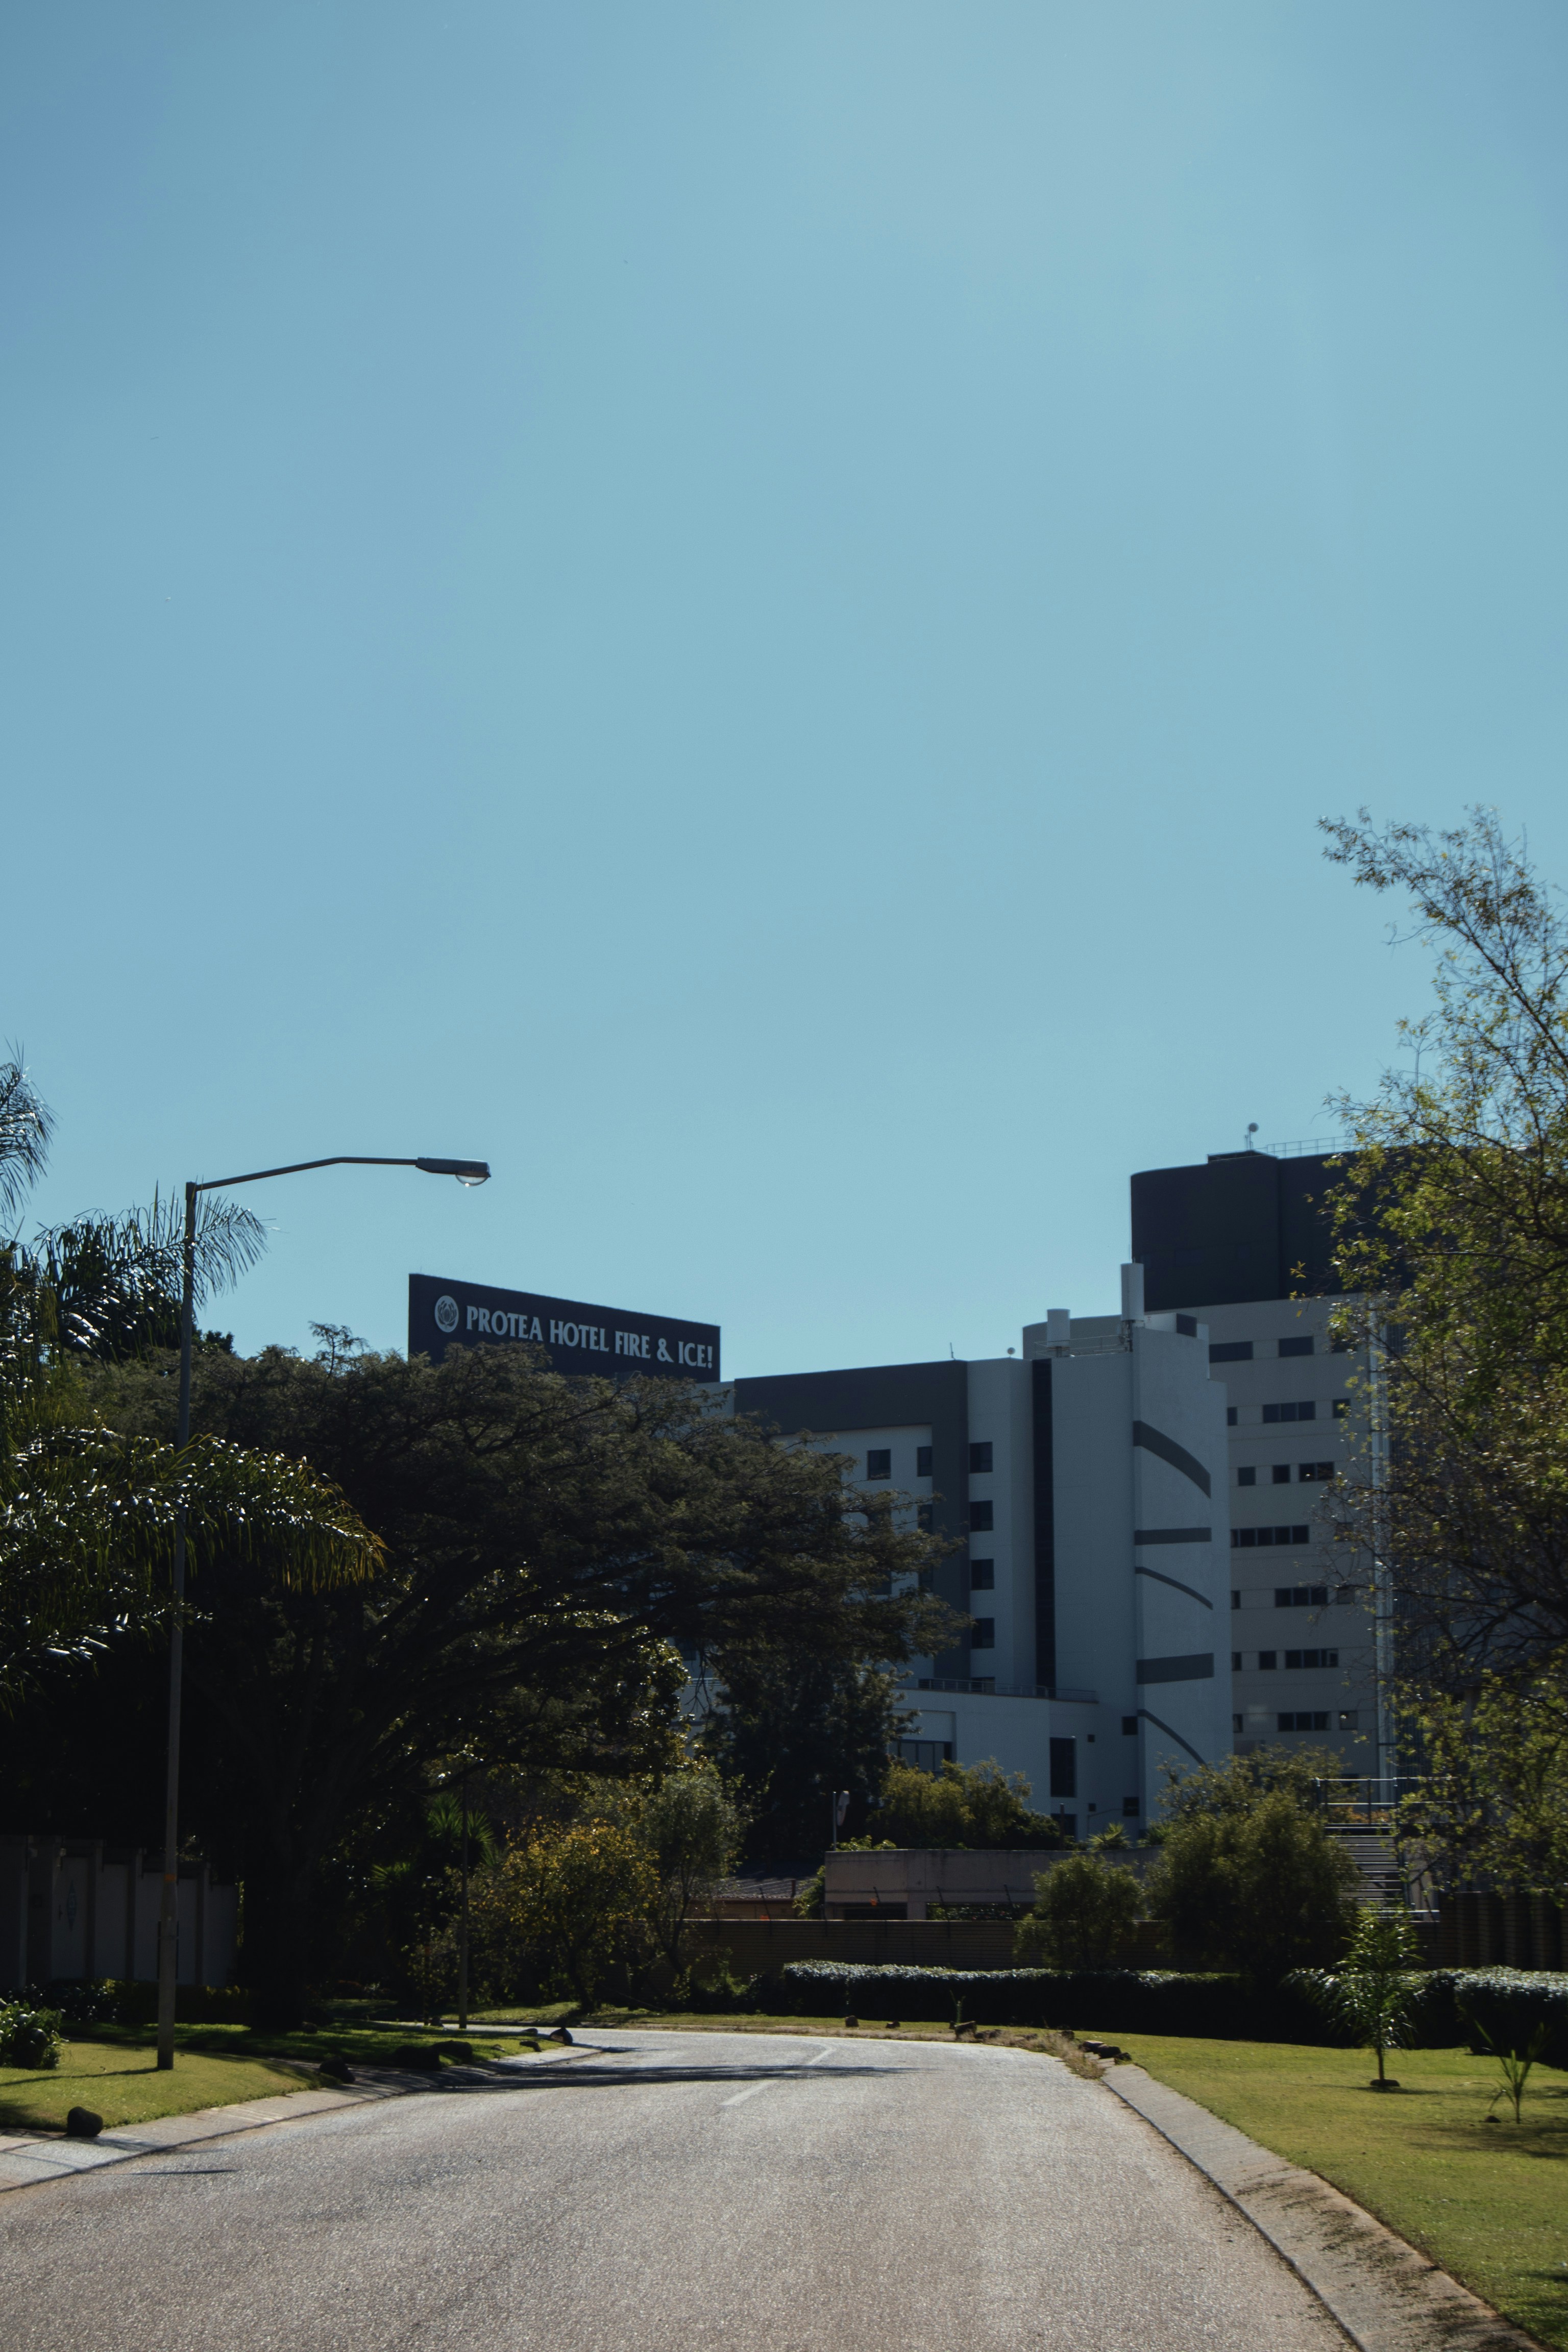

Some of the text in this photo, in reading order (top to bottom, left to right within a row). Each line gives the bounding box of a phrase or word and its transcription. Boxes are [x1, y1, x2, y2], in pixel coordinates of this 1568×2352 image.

[467, 1306, 713, 1368] PROTEA HOTEL FIRE & ICE!
